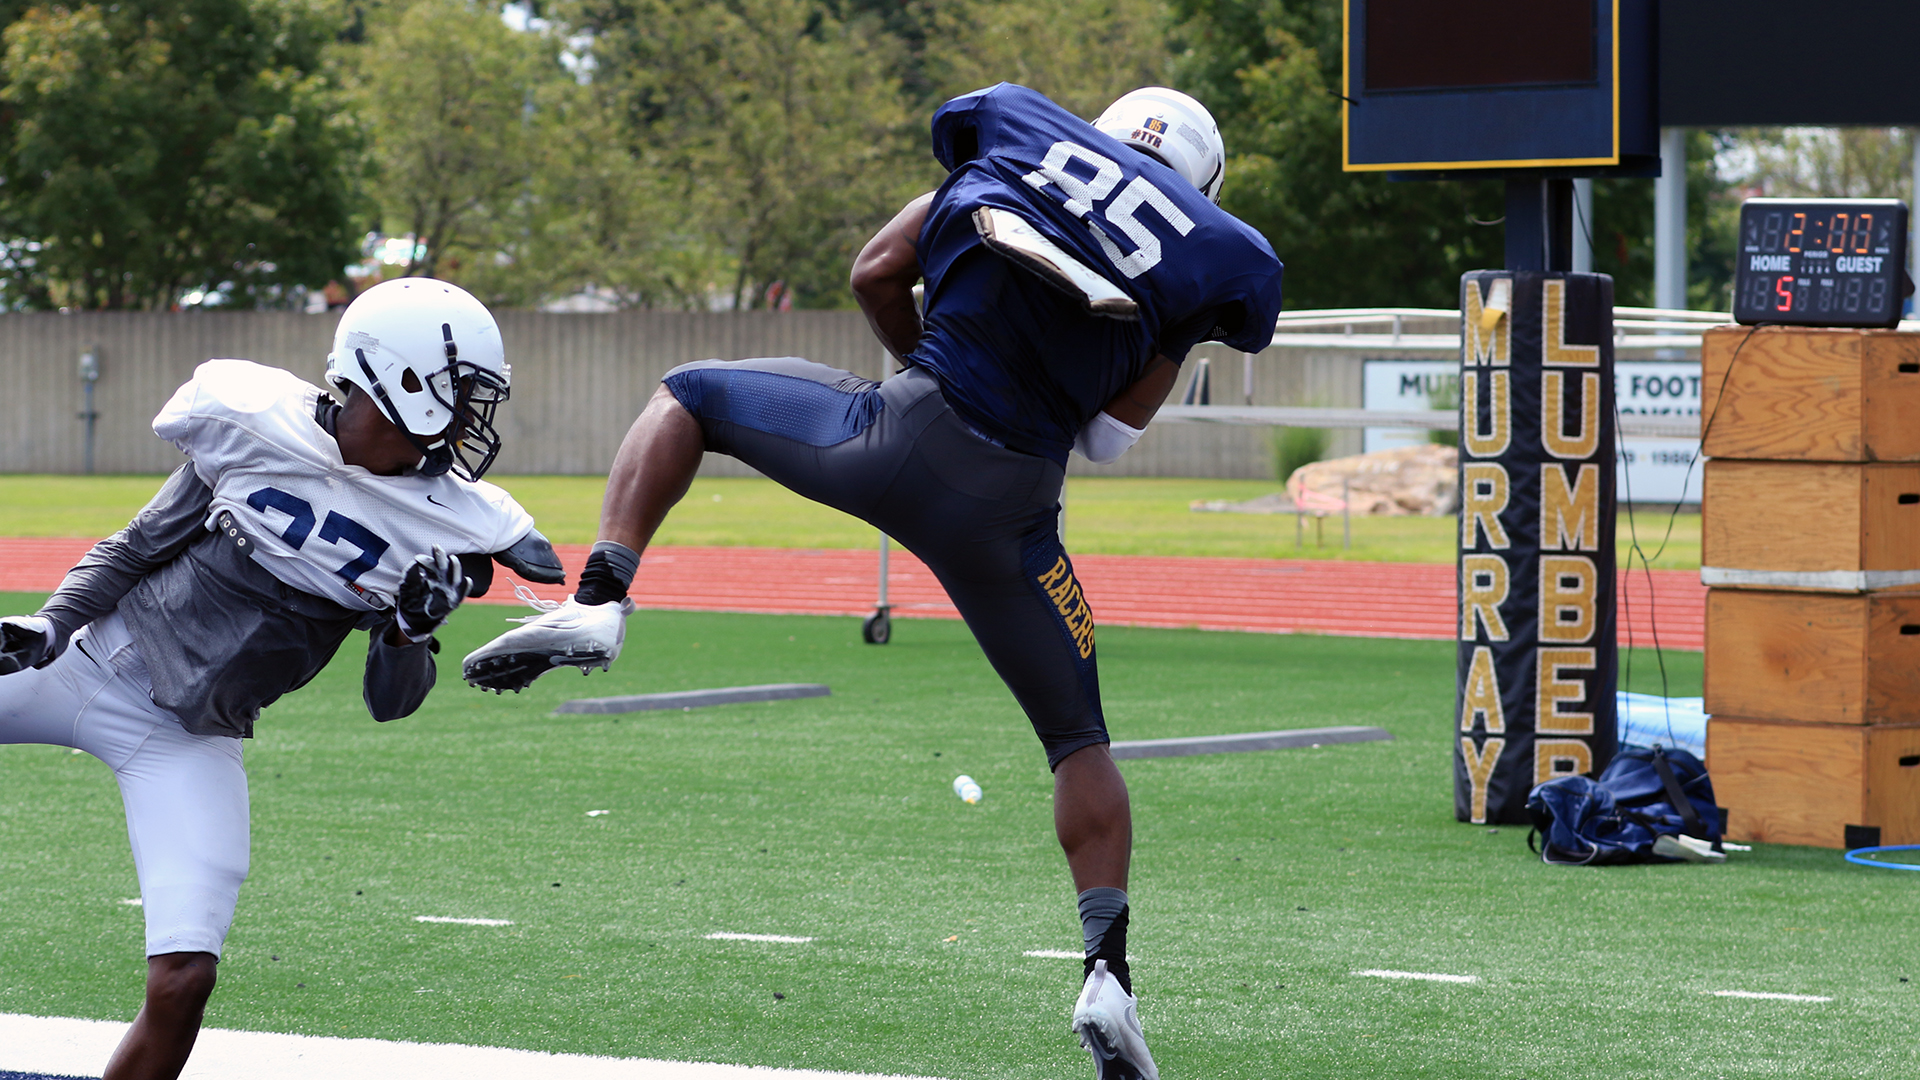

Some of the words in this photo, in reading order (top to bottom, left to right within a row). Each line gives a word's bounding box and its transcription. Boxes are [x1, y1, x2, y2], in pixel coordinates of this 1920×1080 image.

[1131, 129, 1163, 149] #TYR
[1148, 119, 1163, 132] 85
[1021, 140, 1196, 279] 85
[1783, 213, 1873, 254] 2:00
[1750, 255, 1791, 272] HOME
[1835, 256, 1883, 273] GUEST
[1776, 276, 1794, 311] 5
[1460, 278, 1513, 824] MURRAY
[1037, 555, 1094, 659] RACERS
